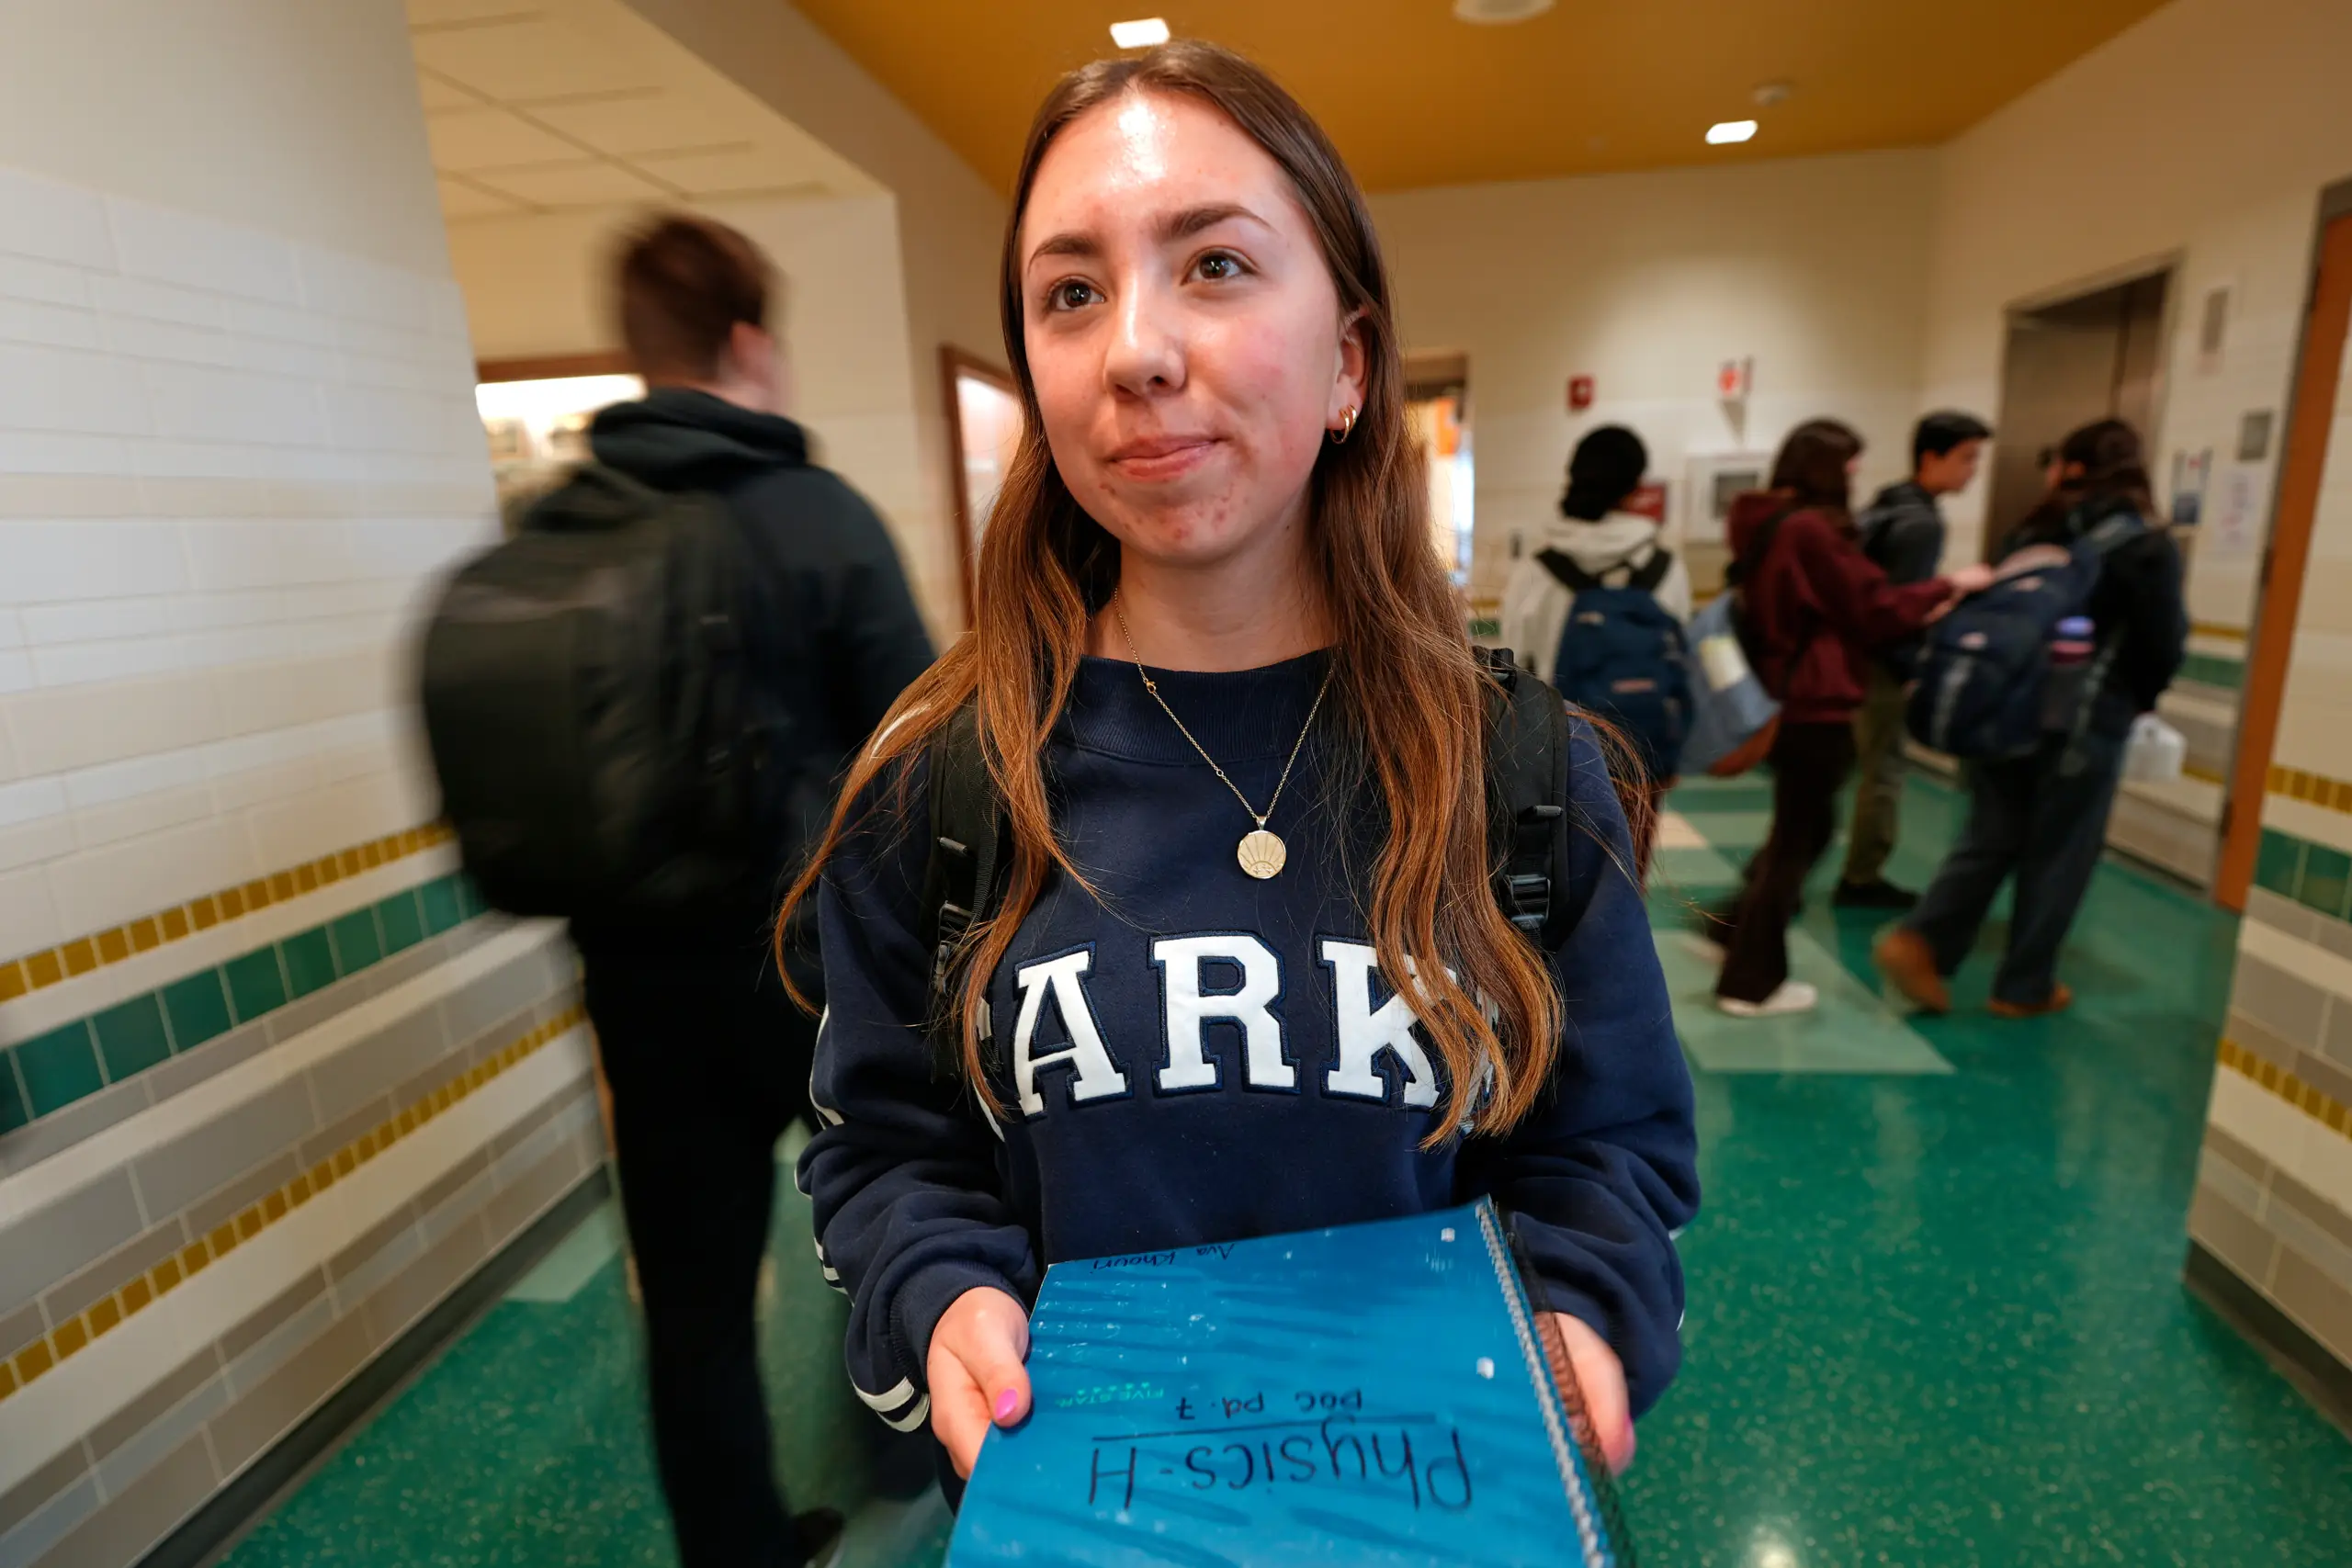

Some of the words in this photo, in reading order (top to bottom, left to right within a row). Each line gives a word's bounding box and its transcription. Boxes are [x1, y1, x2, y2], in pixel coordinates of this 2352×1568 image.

[971, 934, 1501, 1142] ARK
[1090, 1251, 1176, 1274] Khouri
[1196, 1243, 1235, 1260] Ava
[1119, 1387, 1164, 1401] FIVE
[1175, 1396, 1195, 1420] 7
